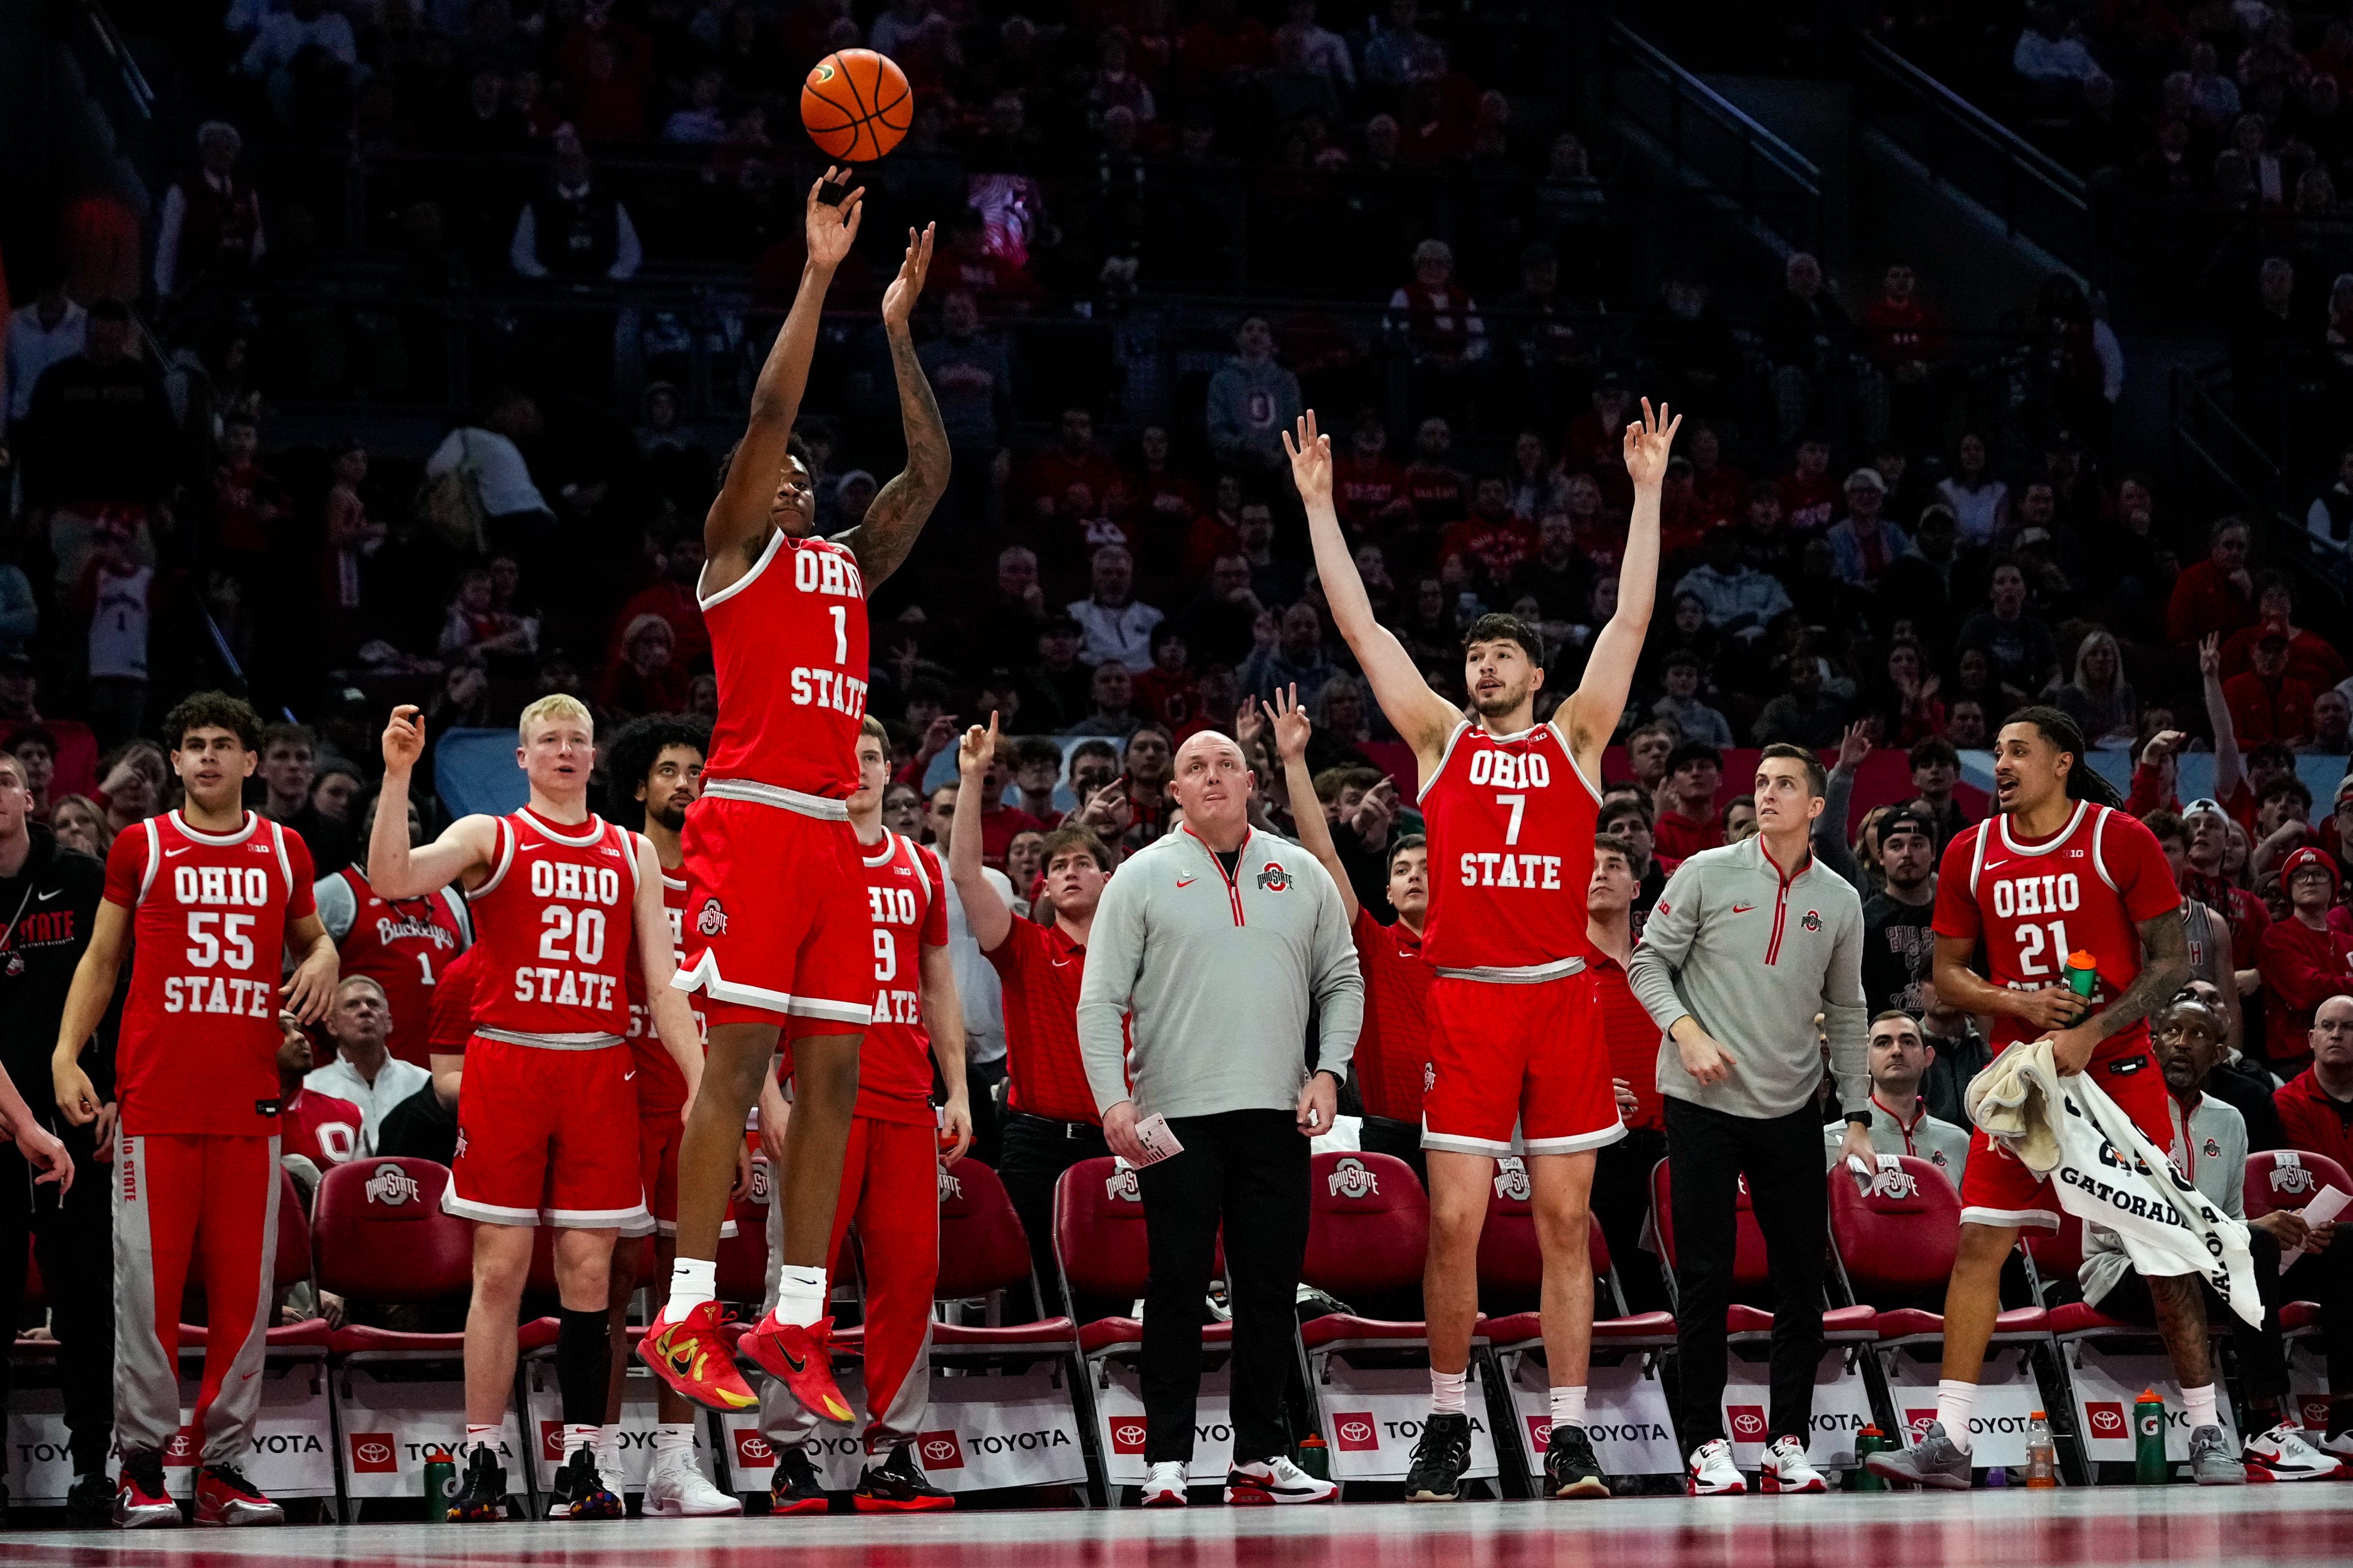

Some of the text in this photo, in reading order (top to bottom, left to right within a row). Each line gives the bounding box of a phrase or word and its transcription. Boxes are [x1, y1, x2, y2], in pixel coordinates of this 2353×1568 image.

[829, 606, 847, 664] 1
[791, 667, 868, 720] STATE
[1469, 750, 1550, 789] OHIO
[1496, 794, 1525, 845] 7
[174, 866, 267, 907] OHIO
[531, 860, 619, 906] OHIO
[1461, 853, 1561, 890] STATE
[868, 886, 916, 925] HIO
[1993, 873, 2080, 918] OHIO
[186, 913, 255, 970] 55
[539, 905, 606, 965] 20
[873, 929, 896, 981] 9
[2015, 920, 2069, 975] 21
[417, 952, 436, 985] 1
[515, 966, 616, 1011] STATE
[164, 976, 270, 1018] STATE
[872, 989, 918, 1024] ATE
[315, 1122, 355, 1162] O
[2060, 1167, 2192, 1230] GATORAD
[966, 1428, 1071, 1456] TOYOTA
[1583, 1423, 1669, 1442] OYOTA
[1808, 1413, 1866, 1431] YOTA
[1969, 1417, 2026, 1434] OYOT
[252, 1435, 323, 1454] YOTA
